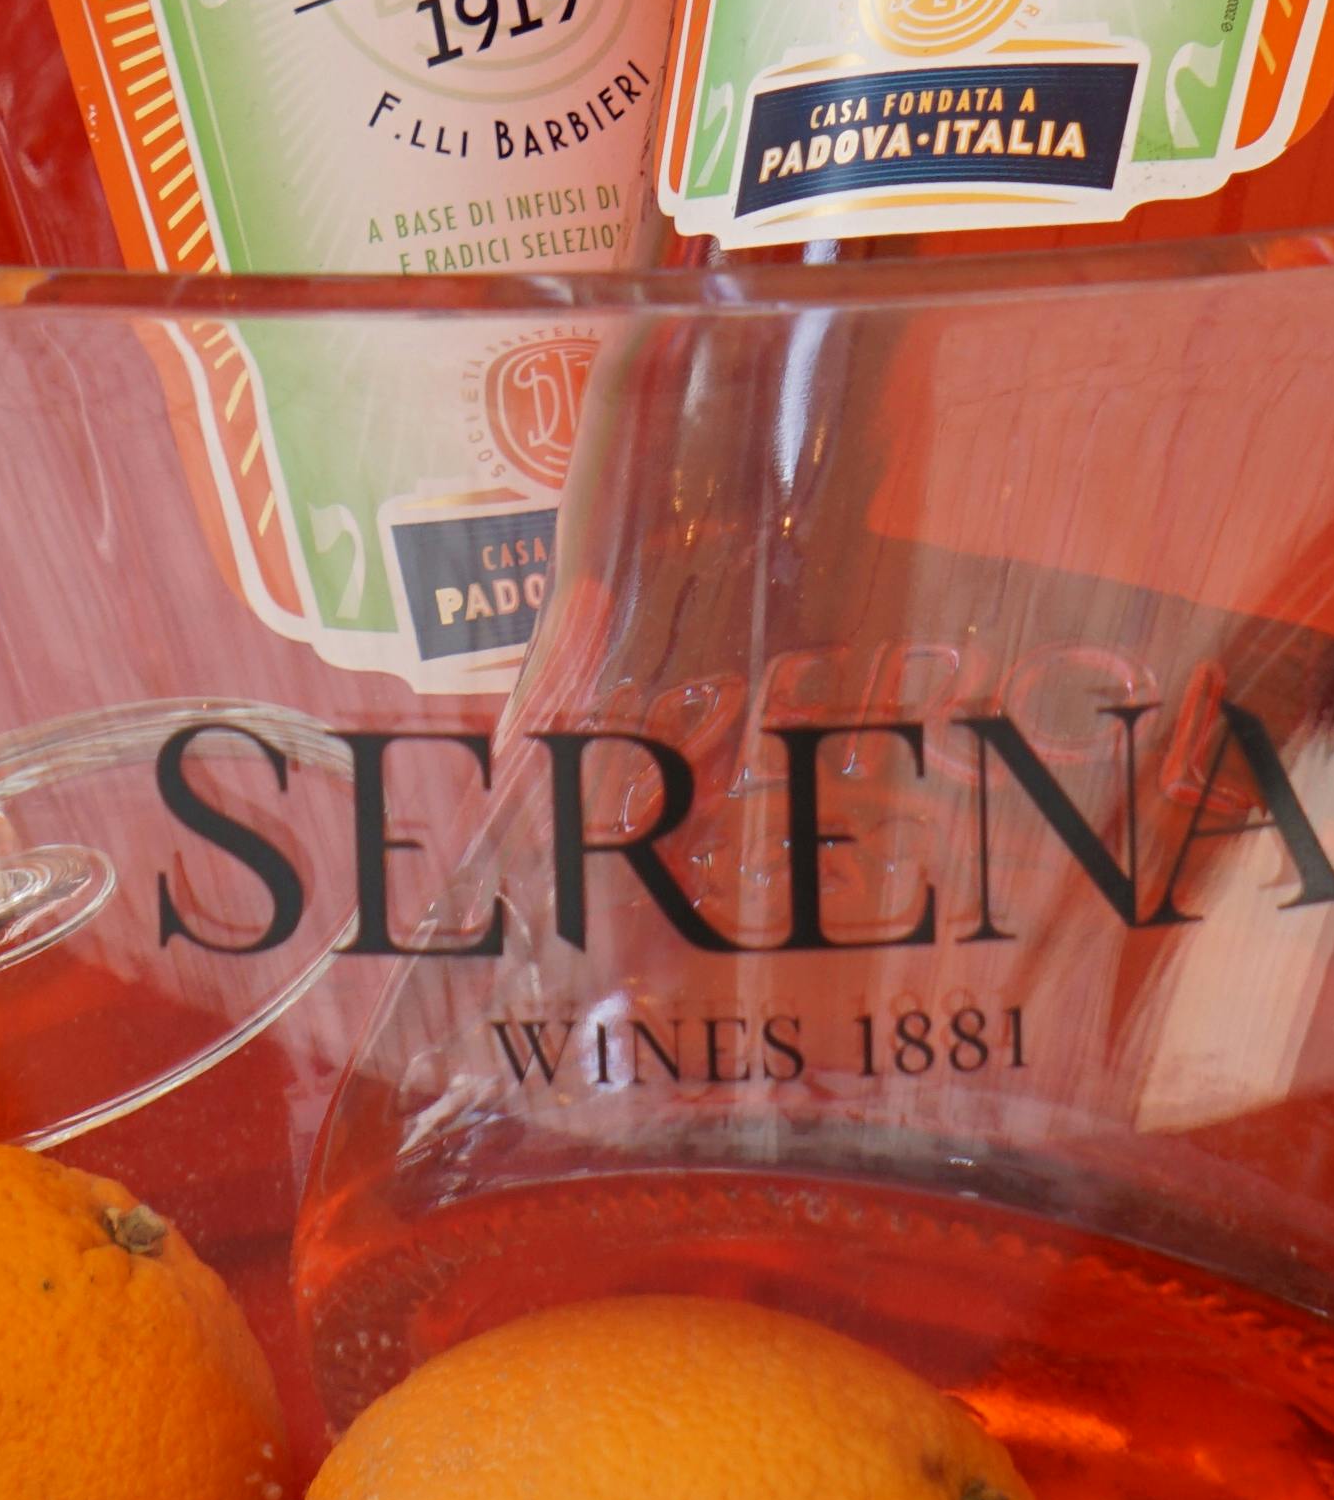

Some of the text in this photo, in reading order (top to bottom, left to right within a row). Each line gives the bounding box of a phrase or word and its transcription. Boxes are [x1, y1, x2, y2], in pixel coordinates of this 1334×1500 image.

[368, 60, 650, 160] F.LLI BARBIERI
[810, 86, 1035, 130] CASA FONDATA A
[369, 184, 620, 244] A BASE DI INFUSI DI
[425, 238, 511, 274] RADICI
[522, 223, 622, 259] SELEZIO
[482, 536, 547, 571] CASA
[435, 572, 545, 626] PADO
[491, 1006, 1031, 1088] WINES 1881
